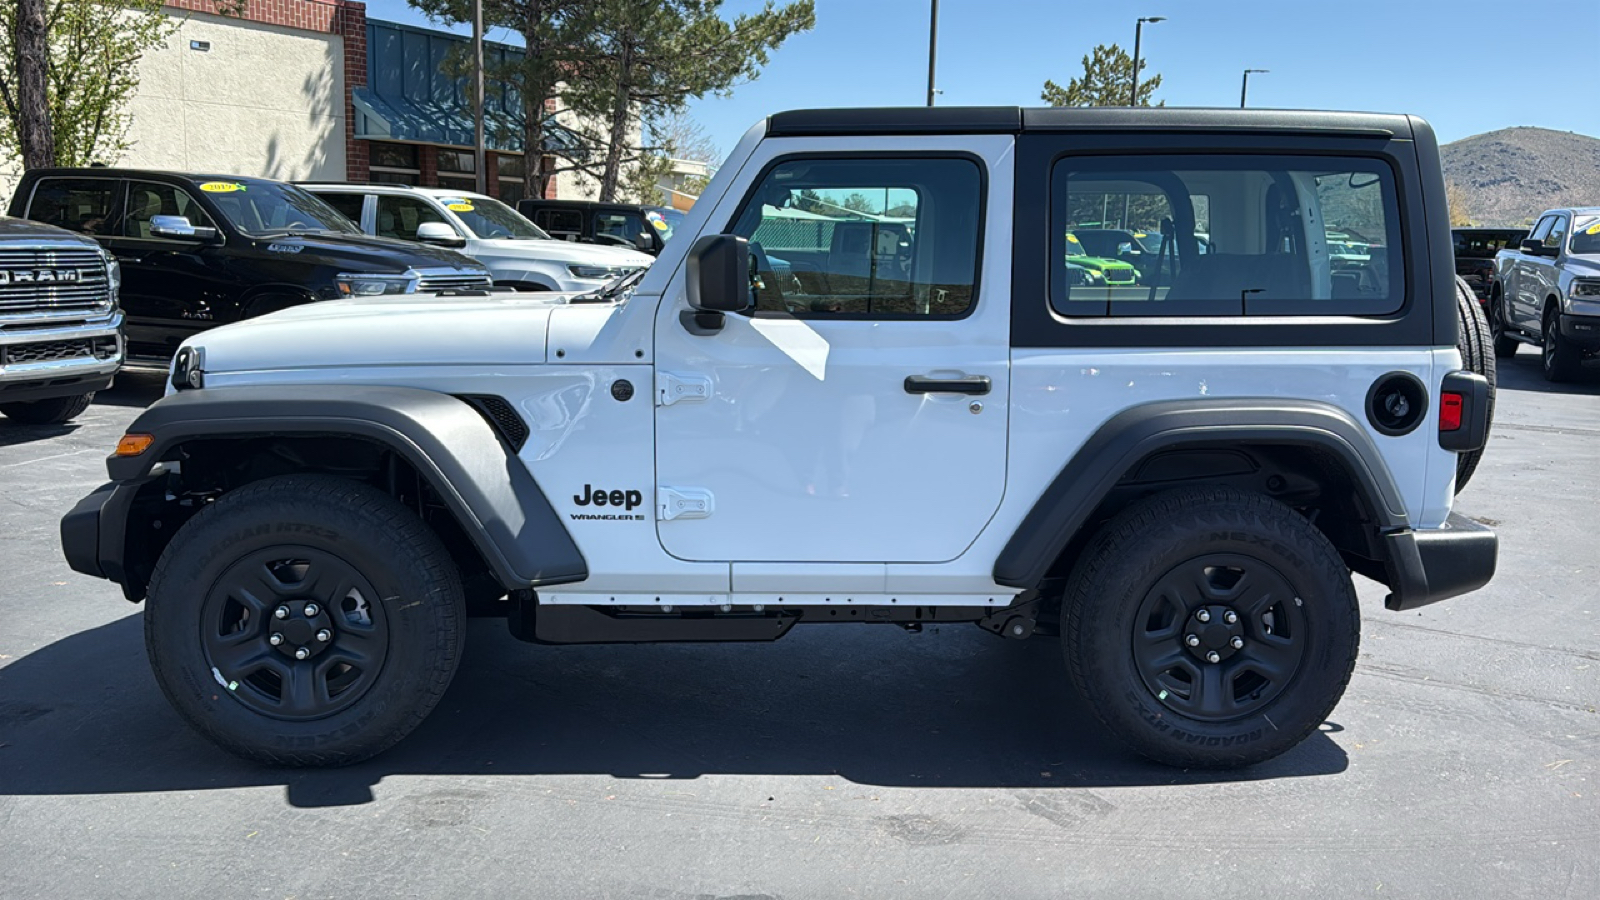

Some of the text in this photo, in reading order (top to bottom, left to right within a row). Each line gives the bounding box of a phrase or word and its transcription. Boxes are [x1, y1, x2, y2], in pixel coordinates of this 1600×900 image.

[13, 269, 76, 281] RAM
[573, 484, 642, 511] Jeep
[1208, 529, 1306, 570] NEXEN
[1169, 725, 1263, 747] ROADIAN
